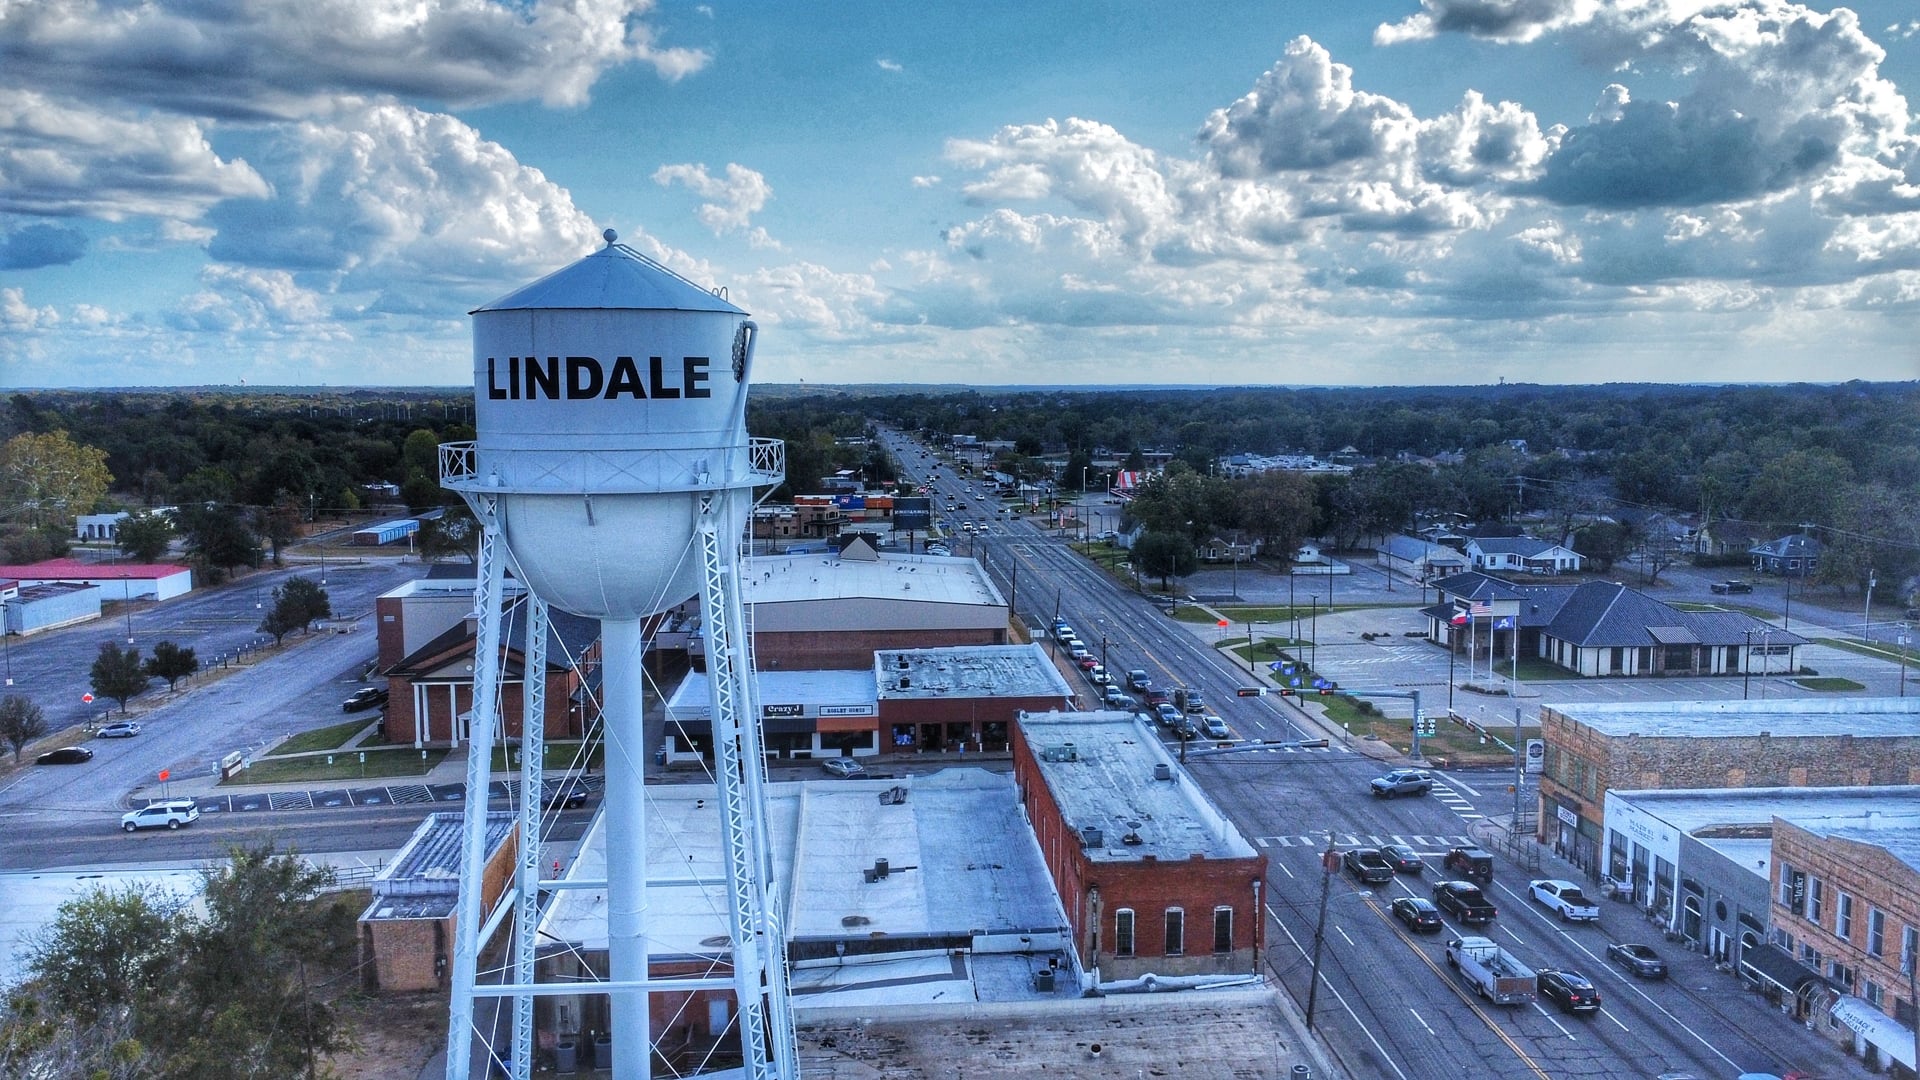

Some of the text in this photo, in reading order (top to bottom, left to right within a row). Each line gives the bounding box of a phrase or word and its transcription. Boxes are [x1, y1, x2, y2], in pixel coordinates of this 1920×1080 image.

[488, 356, 711, 400] LINDALE
[768, 704, 800, 714] Crazy J
